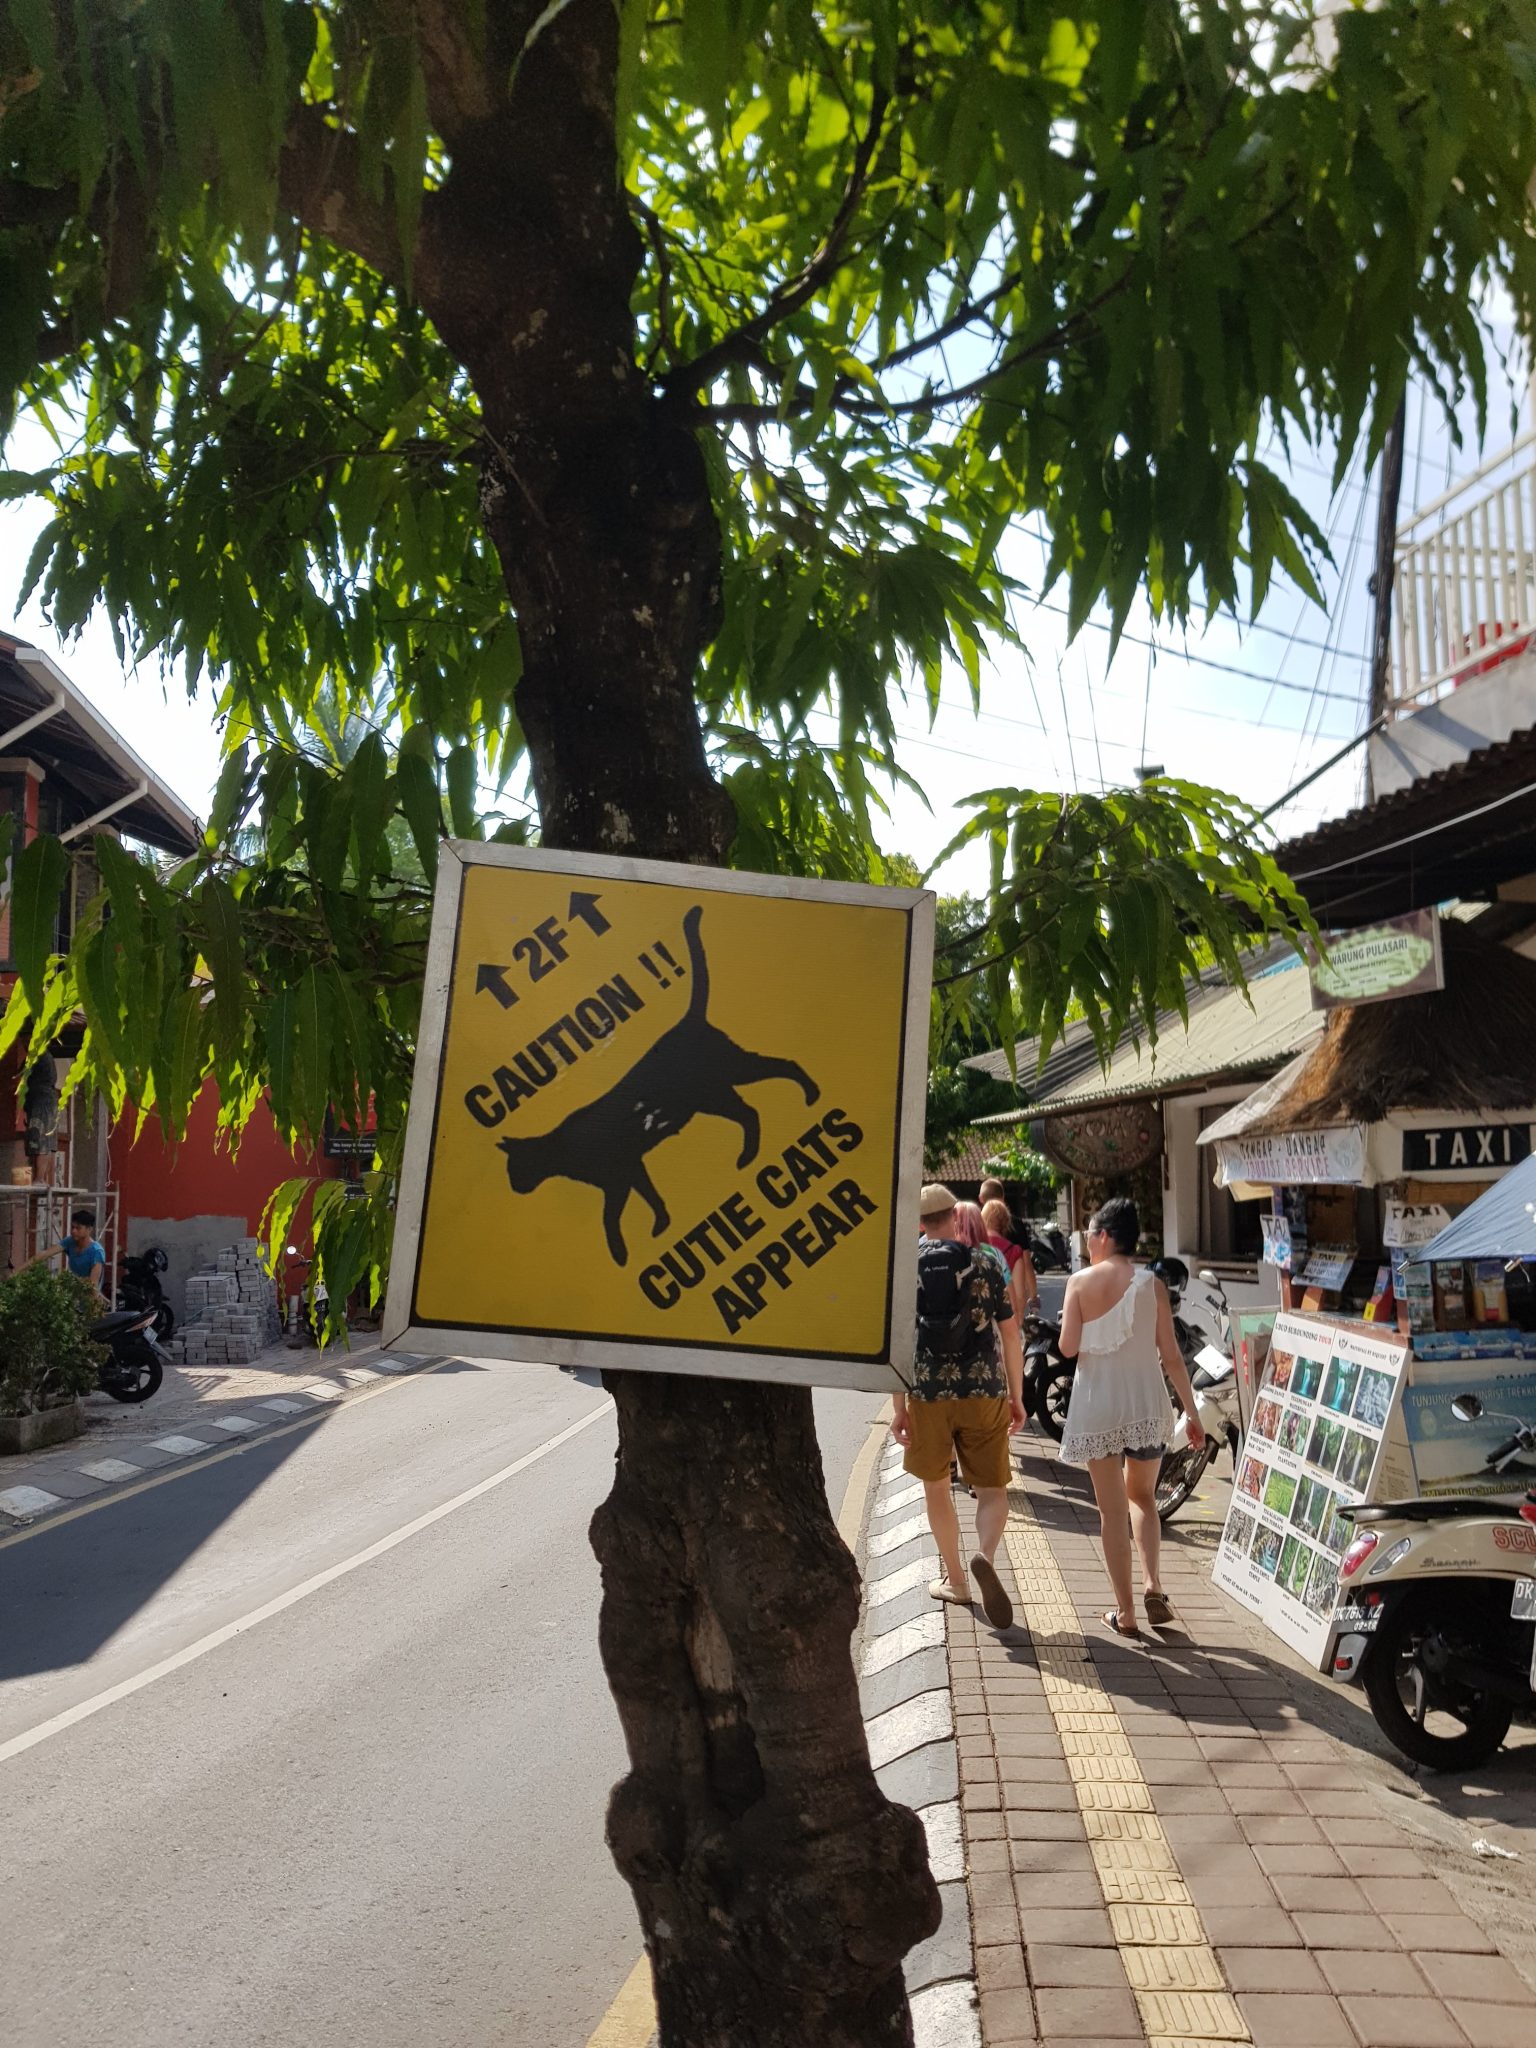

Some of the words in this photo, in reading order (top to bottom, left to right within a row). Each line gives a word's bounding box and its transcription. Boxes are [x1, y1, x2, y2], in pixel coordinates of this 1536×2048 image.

[513, 916, 570, 983] 2F
[1330, 950, 1364, 966] WARUNG
[1367, 938, 1408, 957] PULASARI
[463, 973, 646, 1129] CAUTION
[638, 941, 685, 989] !!
[1424, 1129, 1511, 1166] TAXI
[1246, 1159, 1280, 1178] TOURIST
[1285, 1157, 1329, 1177] SERVICE
[638, 1191, 766, 1310] CUTIE
[756, 1107, 864, 1210] CATS
[711, 1178, 880, 1336] APPEAR
[1319, 1253, 1337, 1262] TAXI
[1515, 1582, 1534, 1600] DK
